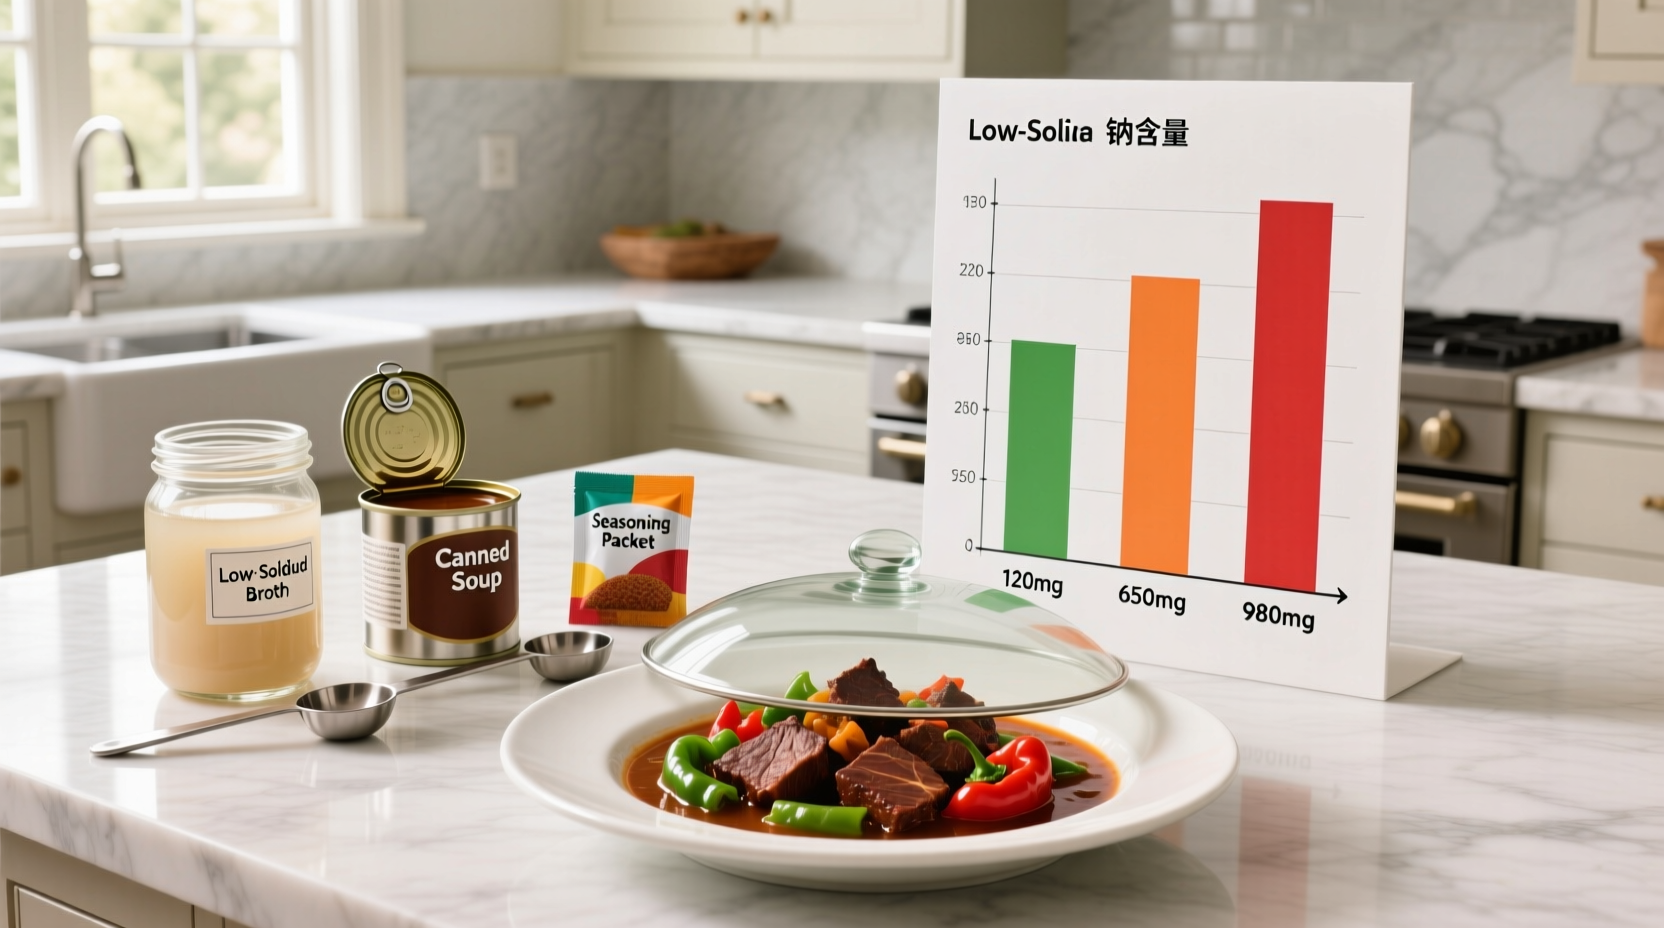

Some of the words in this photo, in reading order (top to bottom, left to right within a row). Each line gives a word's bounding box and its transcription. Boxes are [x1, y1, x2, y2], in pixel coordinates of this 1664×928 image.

[1106, 117, 1189, 147] 钠含量
[959, 262, 984, 278] 220
[591, 512, 671, 535] Seasoning
[602, 531, 655, 550] Packet
[964, 538, 973, 552] 0
[435, 539, 510, 569] Canned
[246, 581, 290, 602] Broth
[451, 570, 503, 593] Soup
[1002, 569, 1064, 599] 120mg
[1118, 585, 1187, 617] 650mg
[1242, 601, 1316, 634] 980mg
